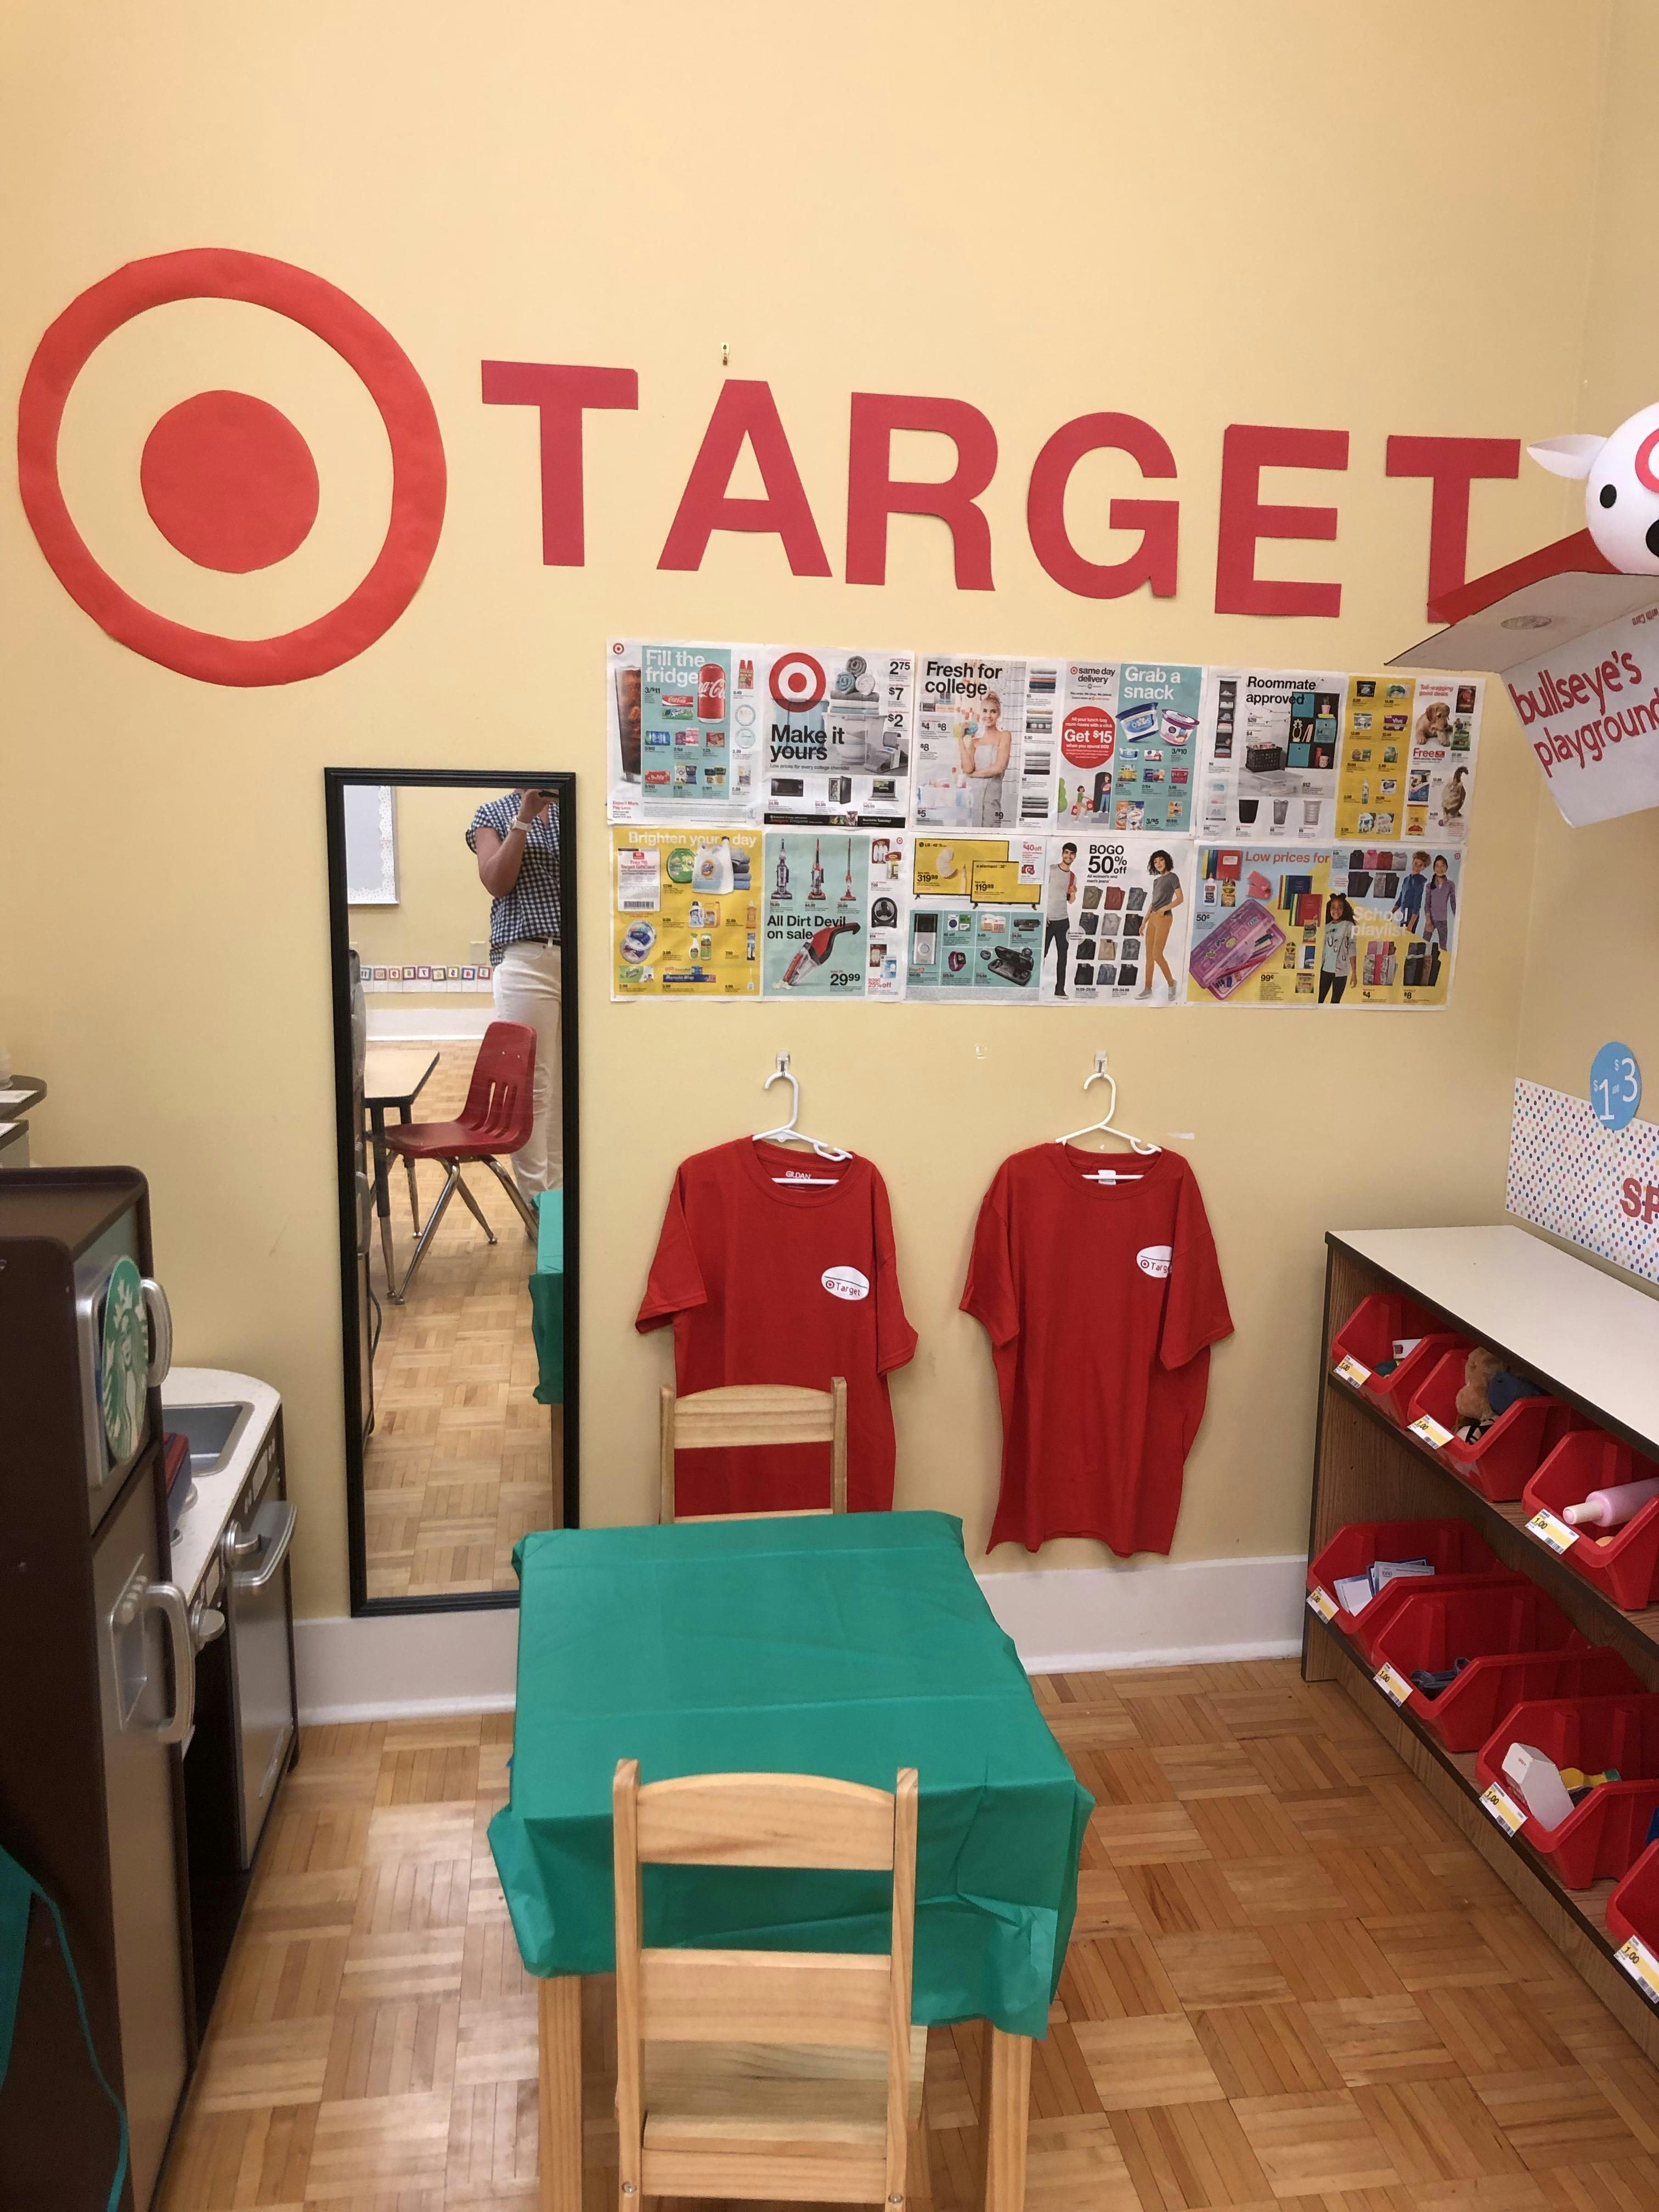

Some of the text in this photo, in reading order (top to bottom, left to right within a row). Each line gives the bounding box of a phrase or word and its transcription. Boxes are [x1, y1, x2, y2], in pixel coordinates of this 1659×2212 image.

[481, 359, 1521, 624] TARGET
[646, 650, 705, 667] Fill the
[646, 667, 698, 687] fridge
[927, 661, 973, 678] Fresh
[978, 664, 1002, 679] for
[1101, 668, 1115, 676] day
[1125, 666, 1181, 683] Grab a
[1078, 675, 1108, 684] delivery
[1248, 676, 1316, 690] Roommate
[889, 687, 904, 700] $7
[925, 678, 987, 698] college
[1124, 685, 1174, 700] snack
[1508, 651, 1642, 725] bullseye's
[1246, 694, 1305, 706] approved
[888, 714, 903, 727] $2
[771, 724, 844, 744] Make it
[1064, 730, 1113, 743] Get $15
[770, 746, 827, 763] yours
[1413, 748, 1435, 758] Free
[629, 832, 756, 847] Brighten your day
[1090, 845, 1124, 855] BOGO
[1088, 855, 1127, 873] 50%
[1245, 851, 1330, 864] Low prices for
[767, 915, 845, 927] All Dirt Devil
[1353, 907, 1408, 922] School
[768, 929, 813, 940] on sale
[1352, 922, 1407, 939] playlist
[786, 1170, 811, 1180] GILDAN
[1151, 1262, 1172, 1274] Targ
[837, 1282, 861, 1296] Target
[1341, 1362, 1350, 1371] 1.00
[1417, 1420, 1429, 1430] 1.00
[1534, 1517, 1548, 1530] 1.00
[1379, 1671, 1390, 1682] 1.00
[1486, 1791, 1499, 1805] 1.00
[1625, 1946, 1640, 1964] 1.00
